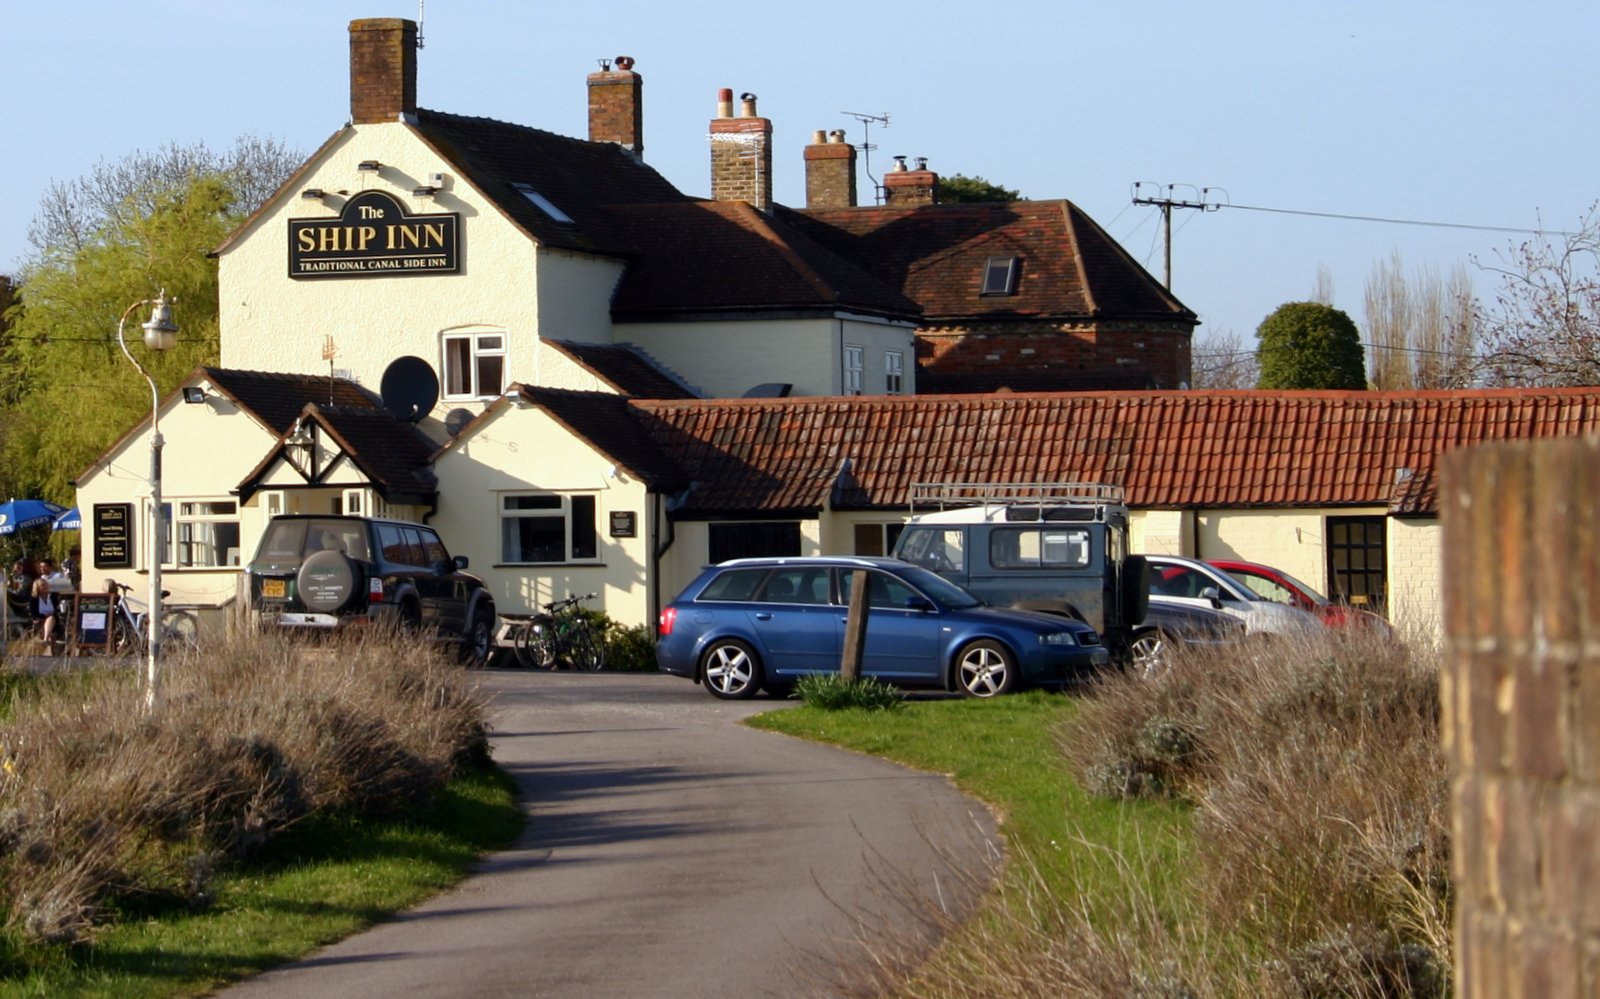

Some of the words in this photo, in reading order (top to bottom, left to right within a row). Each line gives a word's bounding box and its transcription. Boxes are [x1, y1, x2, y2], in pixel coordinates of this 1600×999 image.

[358, 205, 384, 219] The
[298, 226, 376, 252] SHIP
[386, 223, 445, 249] INN
[299, 262, 366, 271] TRADITIONAL
[368, 260, 401, 269] CANAL
[403, 259, 426, 268] SIDE
[428, 258, 447, 267] INN
